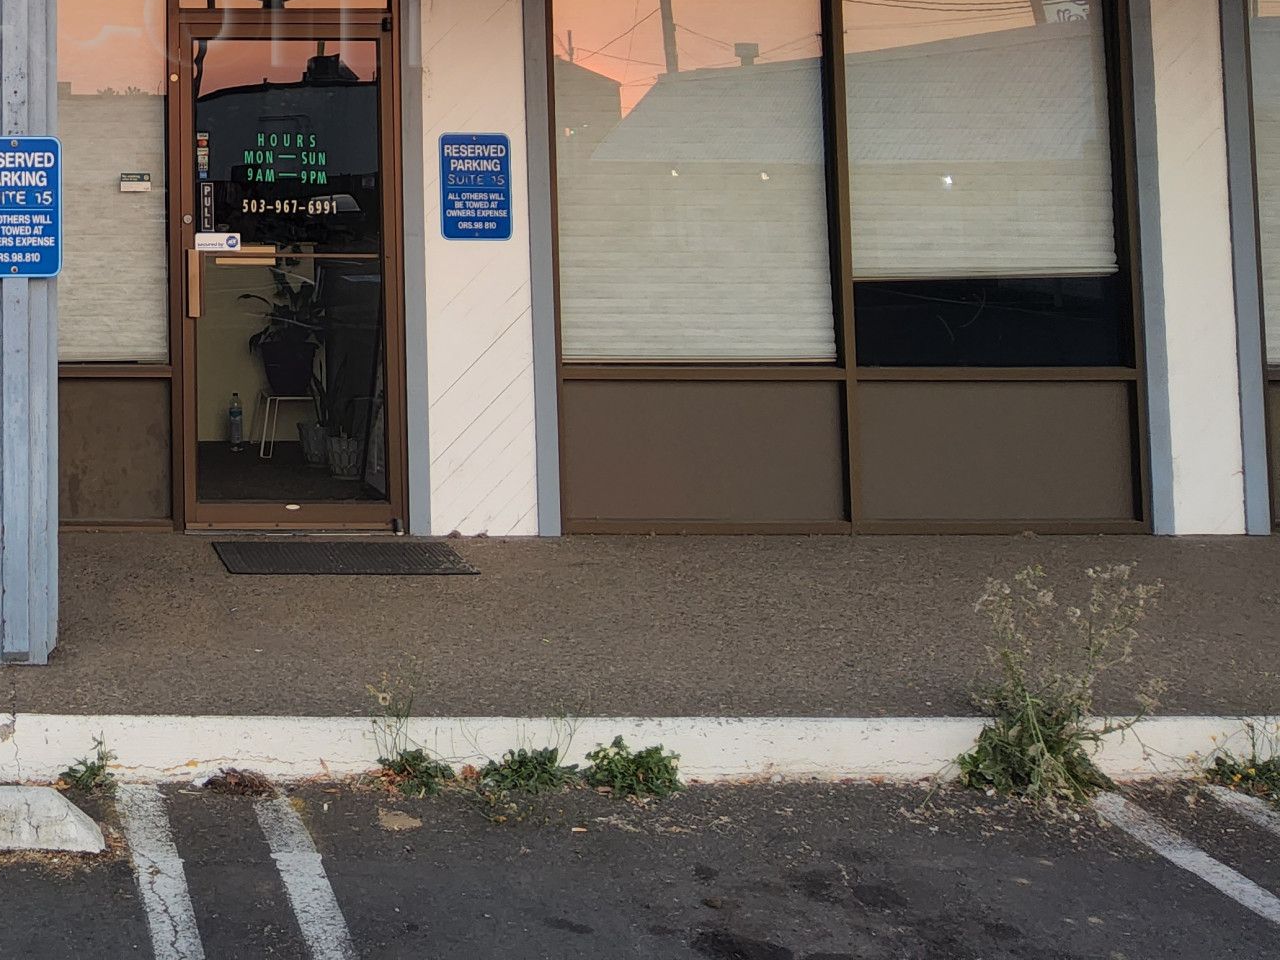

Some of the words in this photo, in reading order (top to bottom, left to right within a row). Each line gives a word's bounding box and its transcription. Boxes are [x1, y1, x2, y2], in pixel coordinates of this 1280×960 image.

[257, 133, 316, 147] HOURS
[444, 145, 506, 157] RESERVED
[244, 151, 273, 164] MON
[301, 152, 326, 165] SUN
[450, 159, 500, 171] PARKING
[247, 168, 275, 182] 9AM
[301, 171, 327, 184] 9PM
[447, 174, 484, 185] SUITE
[35, 191, 53, 205] 15
[242, 200, 338, 214] 503-967-6991
[32, 215, 52, 224] WILL
[1, 226, 31, 235] TOWED
[33, 226, 43, 235] AT
[15, 237, 55, 246] EXPENSE
